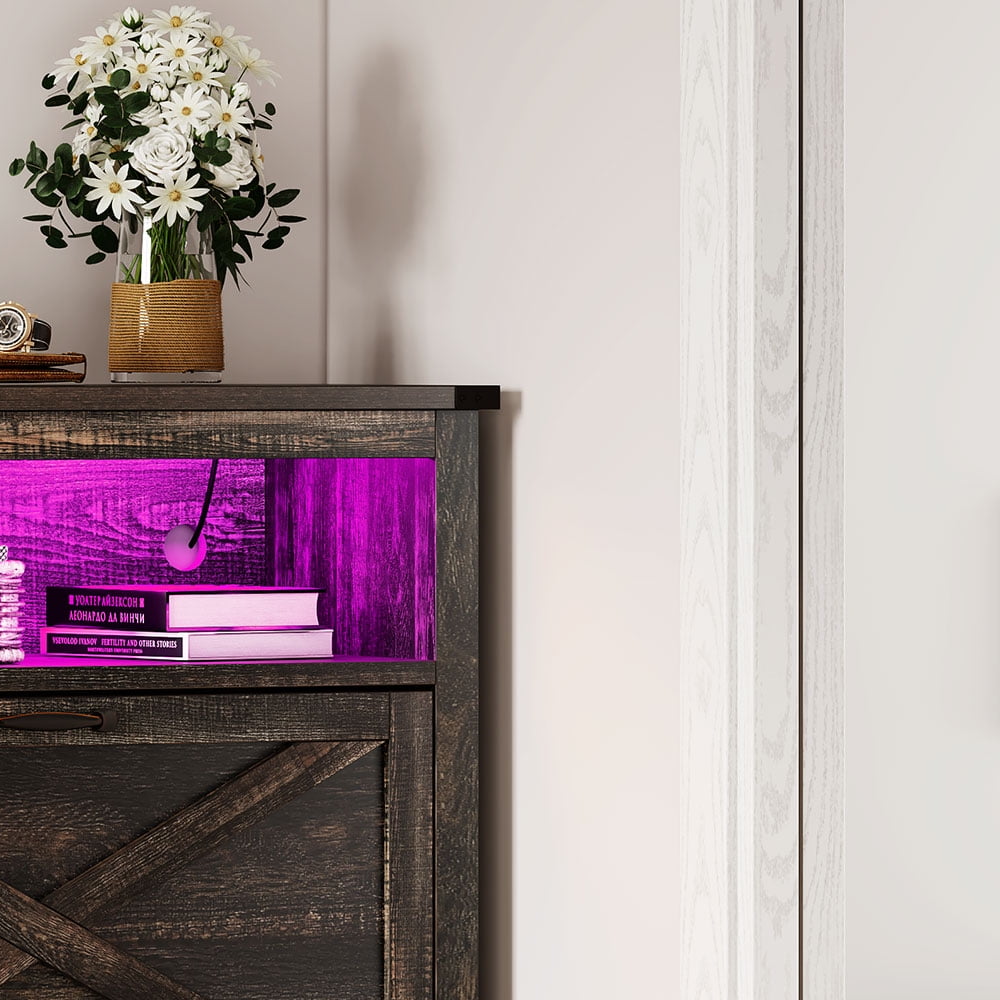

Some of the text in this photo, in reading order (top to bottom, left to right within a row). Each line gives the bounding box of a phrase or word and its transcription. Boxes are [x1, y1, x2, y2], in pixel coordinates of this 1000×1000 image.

[69, 610, 145, 624] ЛЕОНАРДО ДА ВИНЧИ
[101, 638, 126, 647] FERTILITY
[126, 639, 138, 647] AND
[138, 639, 156, 648] OTHER
[156, 640, 178, 648] STORIES
